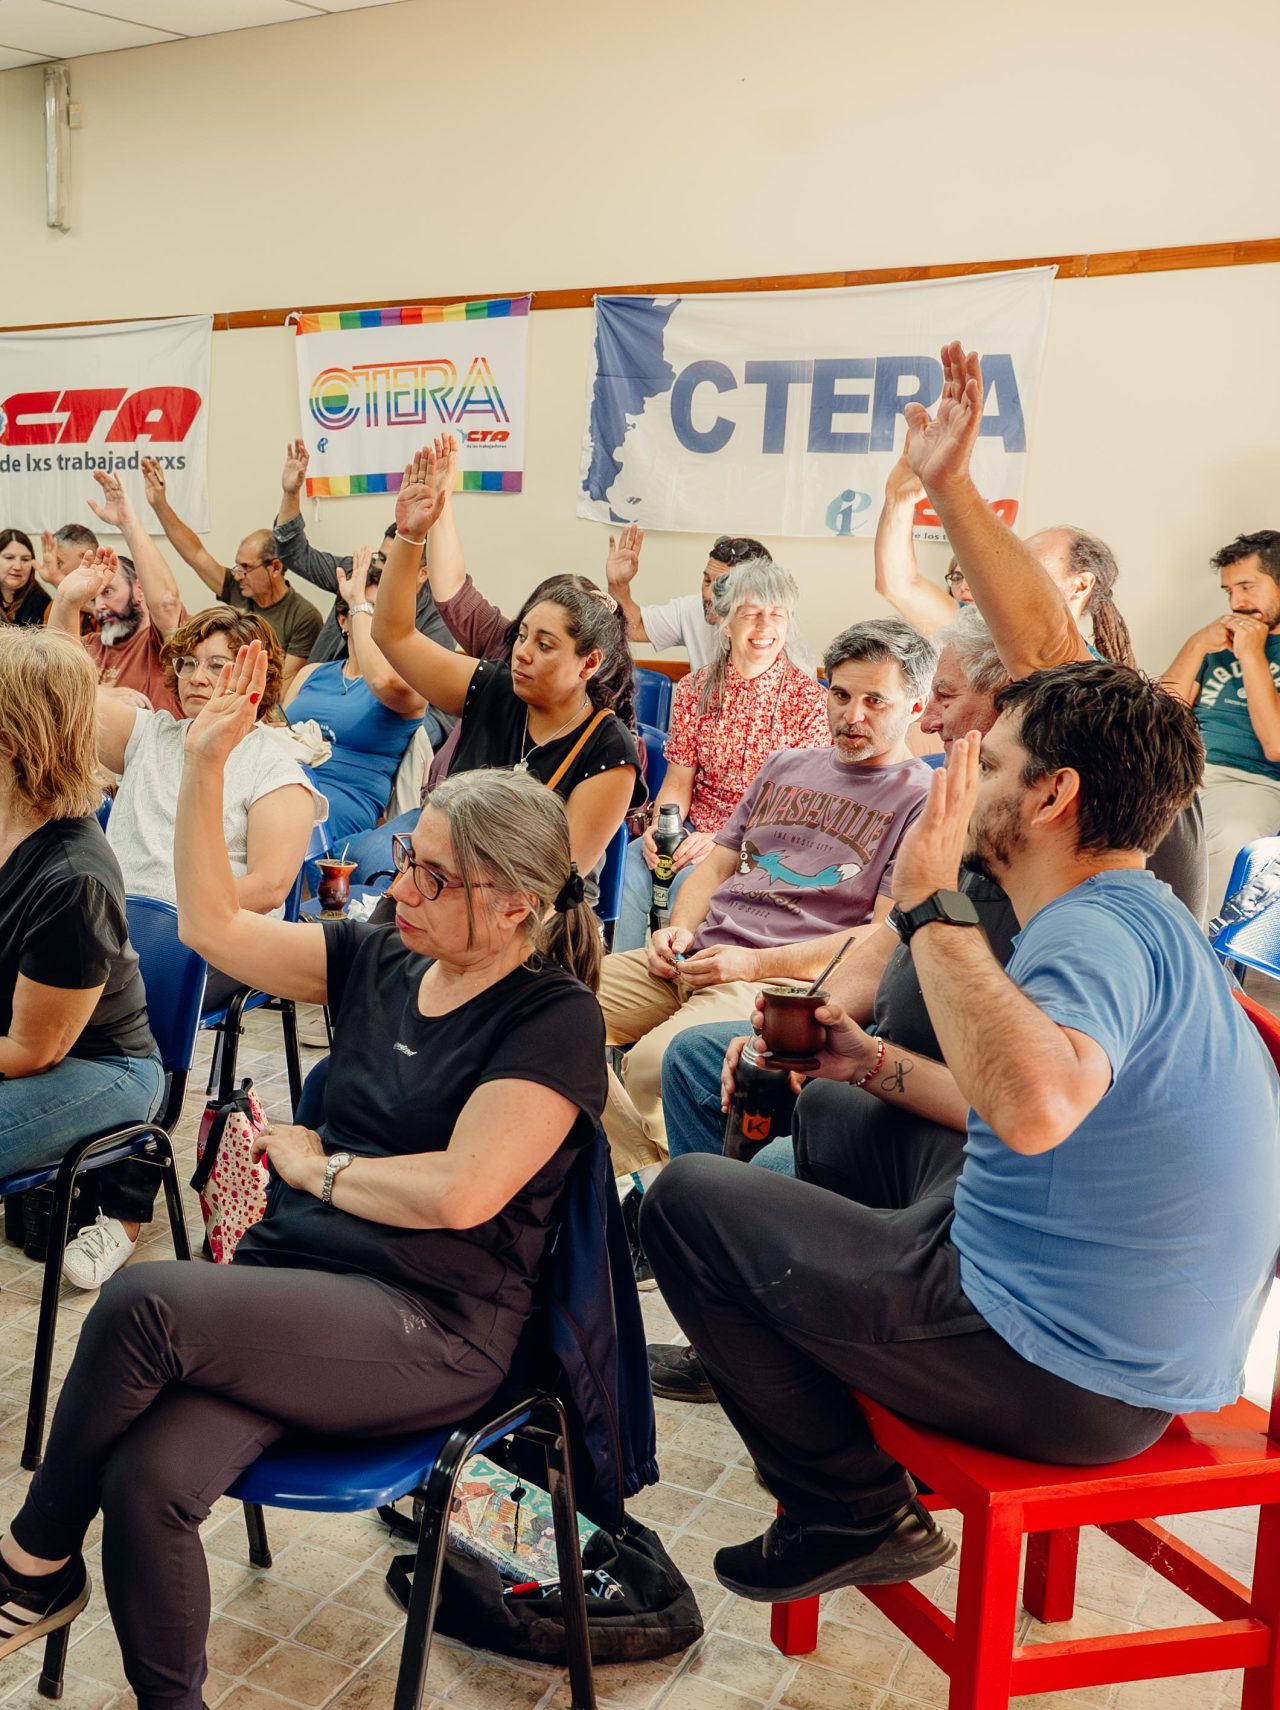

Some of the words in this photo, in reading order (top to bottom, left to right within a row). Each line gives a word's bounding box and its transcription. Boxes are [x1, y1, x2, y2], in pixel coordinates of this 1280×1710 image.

[308, 357, 510, 431] CTERA
[671, 354, 1027, 454] CTERA
[0, 453, 21, 472] de
[26, 452, 52, 472] lxs
[56, 450, 186, 475] trabajadrxs
[467, 430, 510, 442] CTA
[745, 781, 896, 865] NASHVILLE
